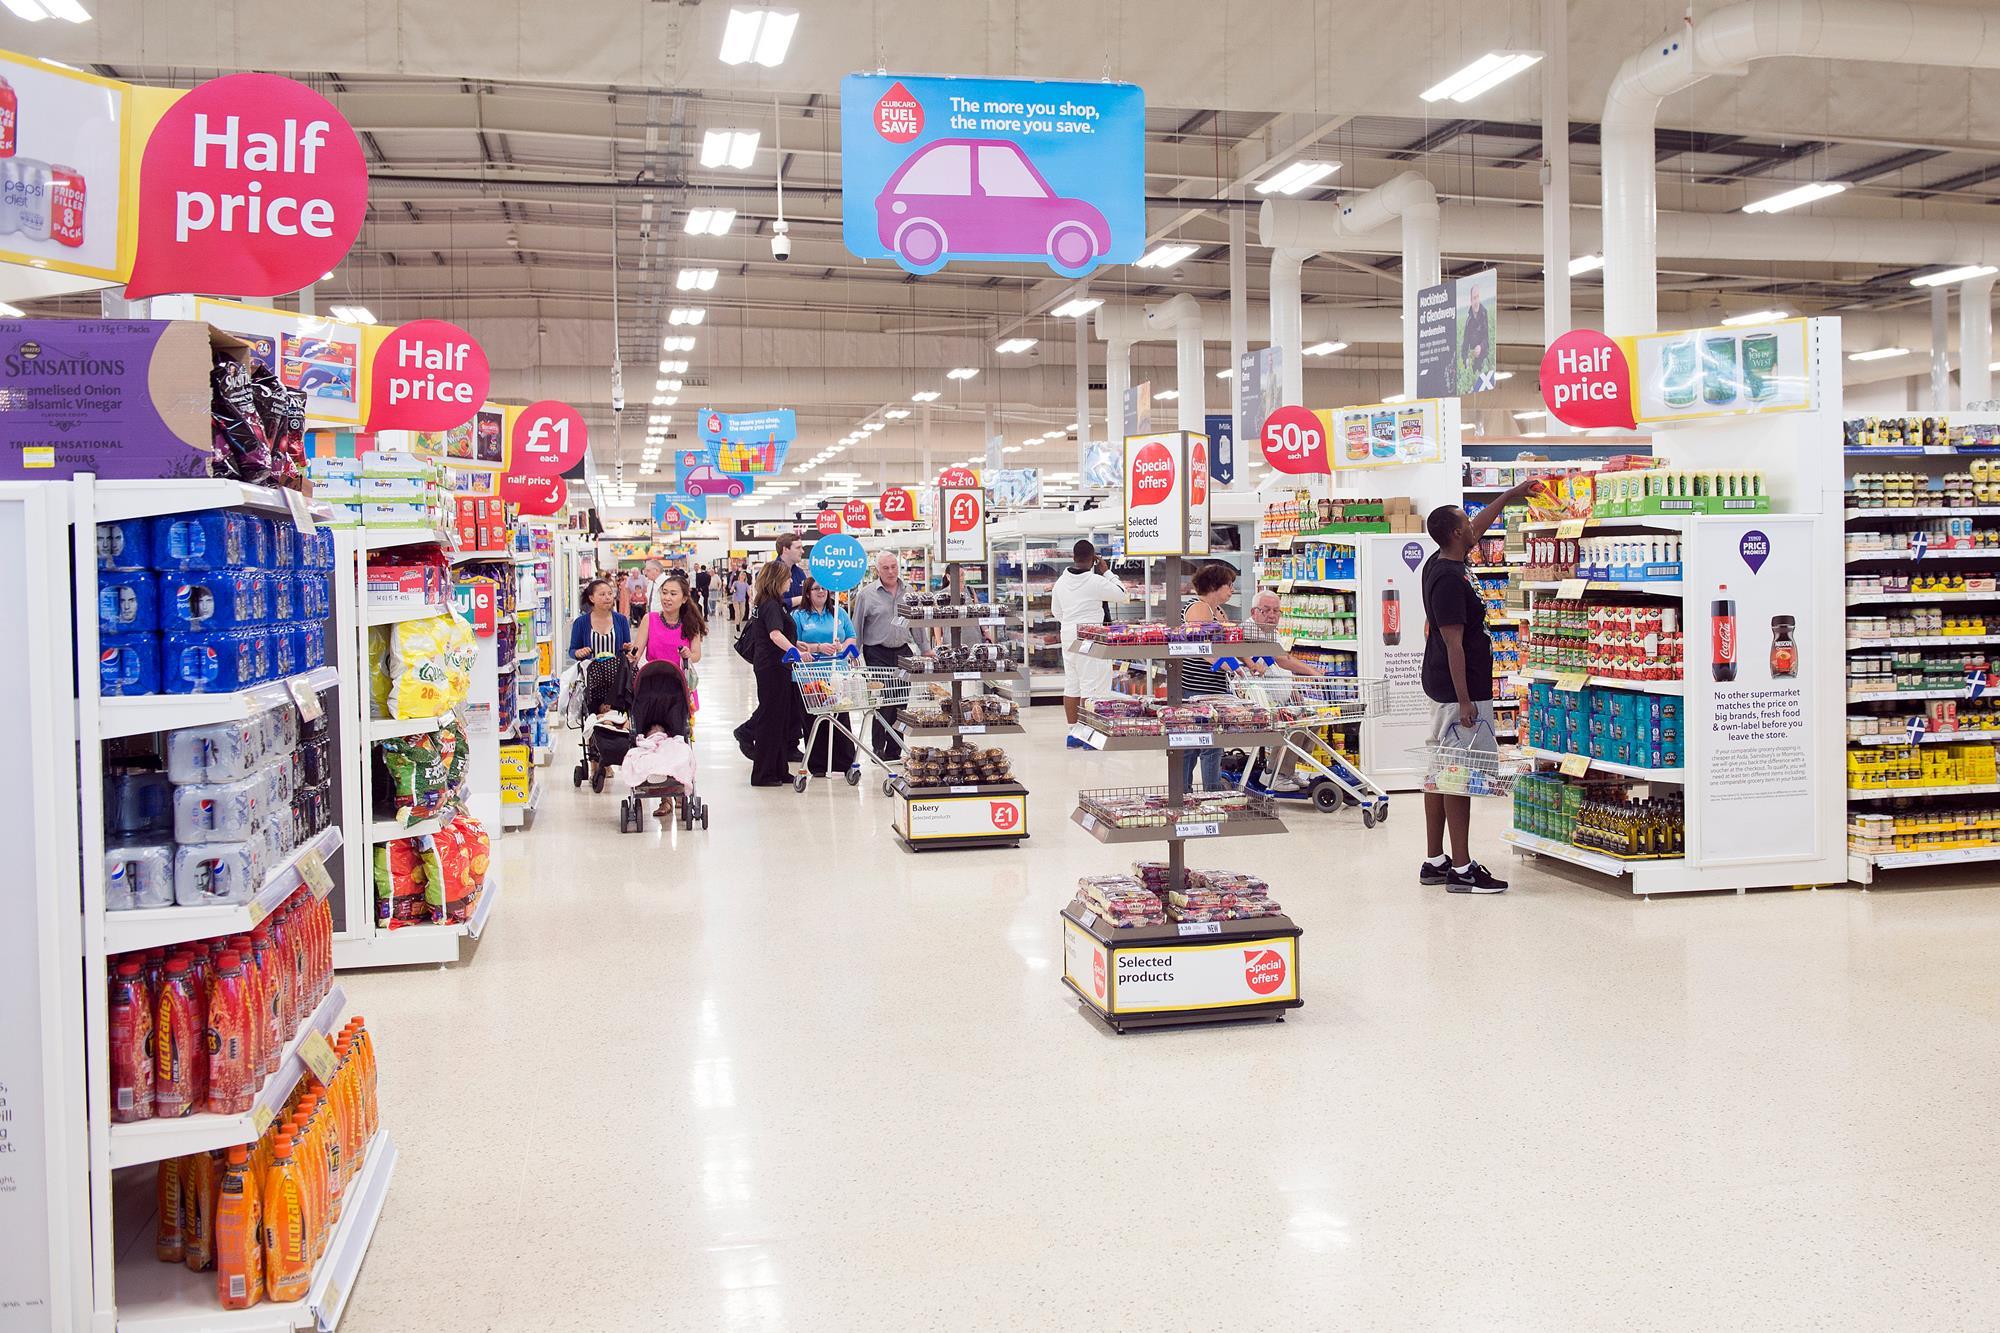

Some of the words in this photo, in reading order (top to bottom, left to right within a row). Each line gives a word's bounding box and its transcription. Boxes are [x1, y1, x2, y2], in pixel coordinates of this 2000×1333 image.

[881, 100, 916, 108] CLUBCARD
[950, 97, 979, 113] The
[984, 102, 1024, 114] more
[1026, 103, 1055, 117] you
[1059, 101, 1100, 120] shop,
[881, 109, 917, 121] FUEL
[881, 121, 917, 134] SAVE
[950, 114, 976, 129] the
[981, 118, 1021, 131] more
[1023, 120, 1053, 135] you
[1056, 121, 1095, 134] save.
[193, 113, 330, 174] Half
[4, 180, 45, 197] pepsi
[54, 186, 84, 202] FRIDGE
[4, 196, 28, 208] diet
[54, 195, 82, 210] FILLER
[63, 208, 74, 227] 8
[175, 181, 335, 243] price
[53, 223, 82, 238] PACK
[259, 343, 270, 352] 24
[399, 339, 471, 371] Half
[1557, 347, 1612, 375] Half
[1749, 350, 1770, 361] JOHN
[9, 384, 80, 395] amelised
[84, 385, 121, 396] Onion
[389, 374, 472, 405] price
[1554, 377, 1618, 408] price
[75, 399, 122, 412] Vinegar
[1218, 423, 1231, 431] Milk
[525, 417, 568, 453] £1
[1266, 423, 1320, 457] 50p
[48, 440, 123, 449] SENSATIONAL
[54, 455, 95, 463] AVOURS
[539, 454, 559, 463] each
[1135, 458, 1171, 475] Special
[528, 476, 551, 485] price
[942, 478, 948, 486] 3
[958, 477, 974, 486] £10
[1138, 476, 1168, 489] offers
[848, 504, 864, 513] Half
[885, 496, 905, 512] £2
[953, 498, 973, 519] £1
[821, 513, 837, 522] Half
[847, 513, 867, 522] price
[1128, 516, 1158, 526] Selected
[819, 521, 838, 530] price
[1128, 529, 1159, 540] products
[947, 538, 965, 546] Bakery
[1743, 542, 1766, 550] PRICE
[824, 545, 846, 556] Can
[849, 546, 853, 556] I
[811, 556, 835, 569] help
[837, 558, 865, 569] you?
[1198, 645, 1210, 654] NEW
[1714, 692, 1725, 700] No
[1728, 691, 1749, 699] other
[1751, 689, 1800, 700] supermarket
[1716, 701, 1751, 710] matches
[1768, 700, 1787, 709] price
[1715, 713, 1727, 722] big
[1729, 711, 1759, 720] brands,
[1761, 710, 1780, 718] fresh
[1783, 709, 1800, 717] food
[1713, 723, 1719, 731] &
[1721, 722, 1760, 731] own-label
[1762, 720, 1787, 729] before
[1788, 721, 1803, 729] you
[1199, 736, 1210, 744] NEW
[1729, 733, 1749, 741] leave
[1751, 732, 1764, 740] the
[912, 805, 939, 813] Bakery
[994, 807, 1013, 823] £1
[1205, 825, 1217, 834] NEW
[1207, 925, 1218, 933] NEW
[1118, 956, 1172, 968] Selected
[1249, 959, 1281, 973] Special
[1118, 972, 1174, 985] products
[1252, 973, 1279, 984] offers
